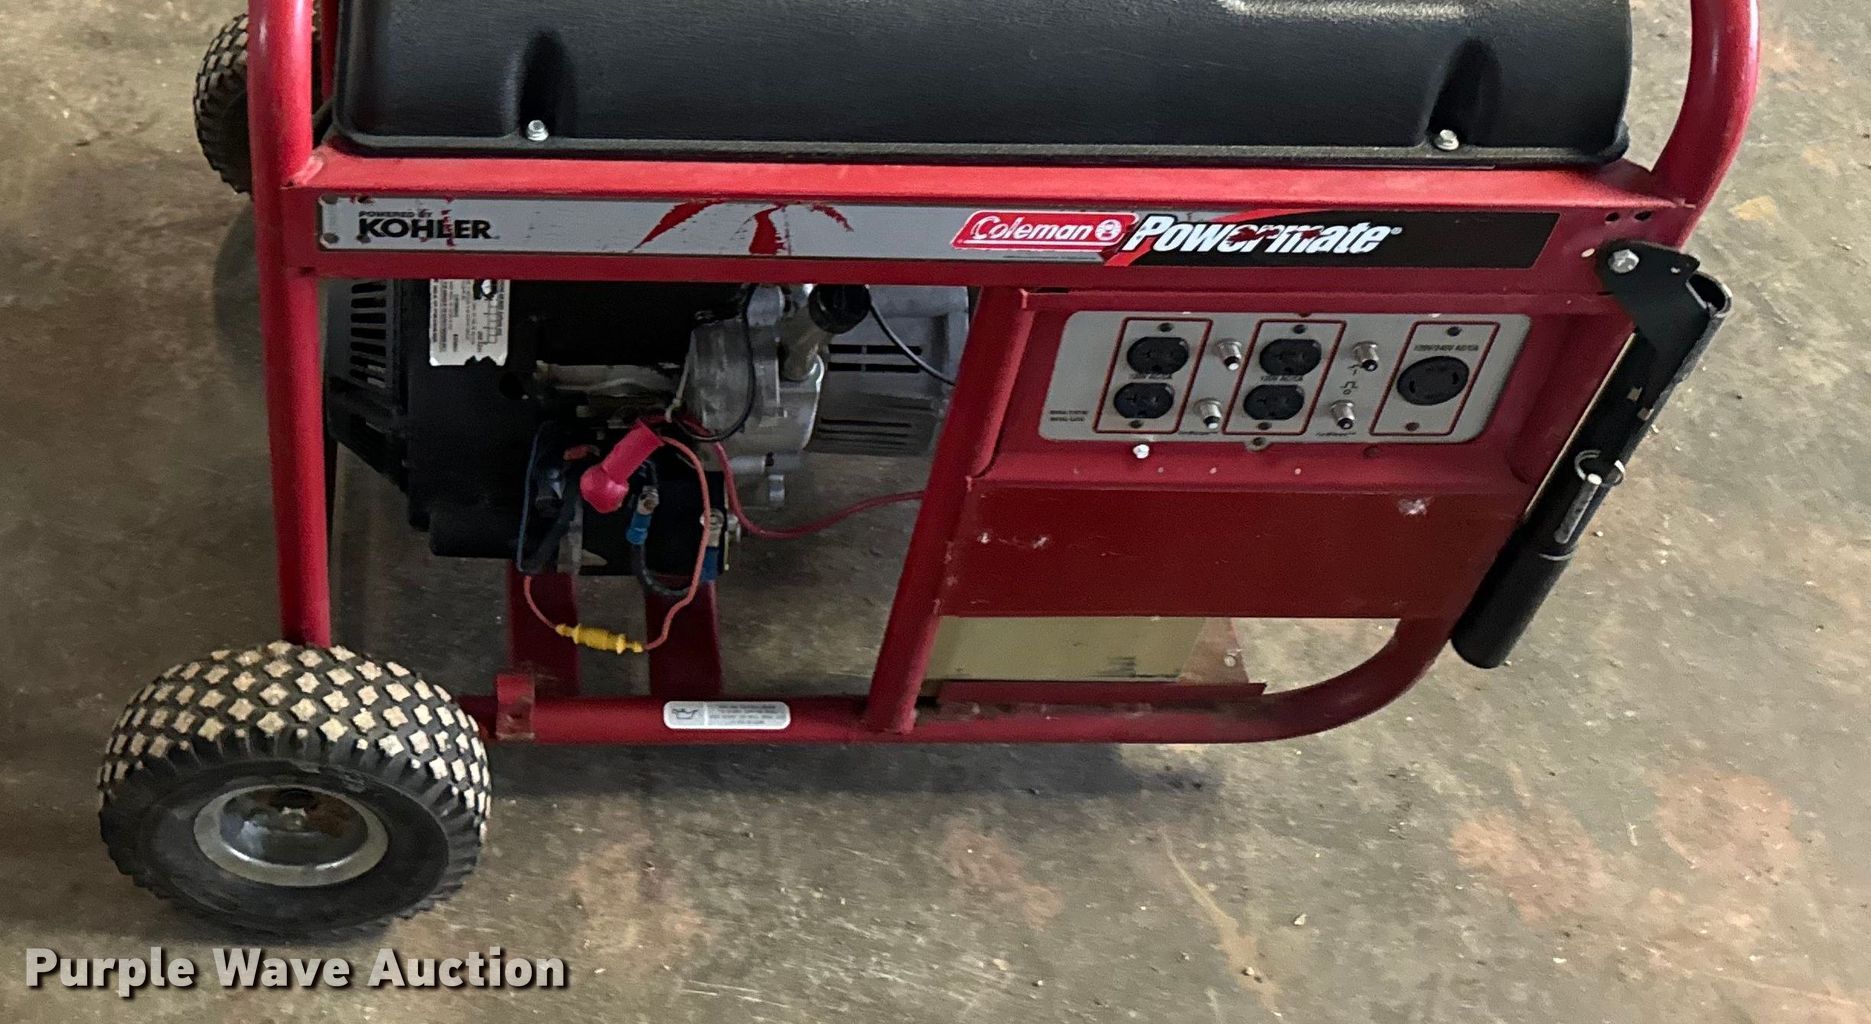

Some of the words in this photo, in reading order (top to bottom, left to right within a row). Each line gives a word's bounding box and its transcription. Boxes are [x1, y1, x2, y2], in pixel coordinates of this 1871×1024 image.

[358, 210, 415, 218] POWERED
[358, 218, 493, 239] KOHLER
[970, 215, 1094, 240] Coleman
